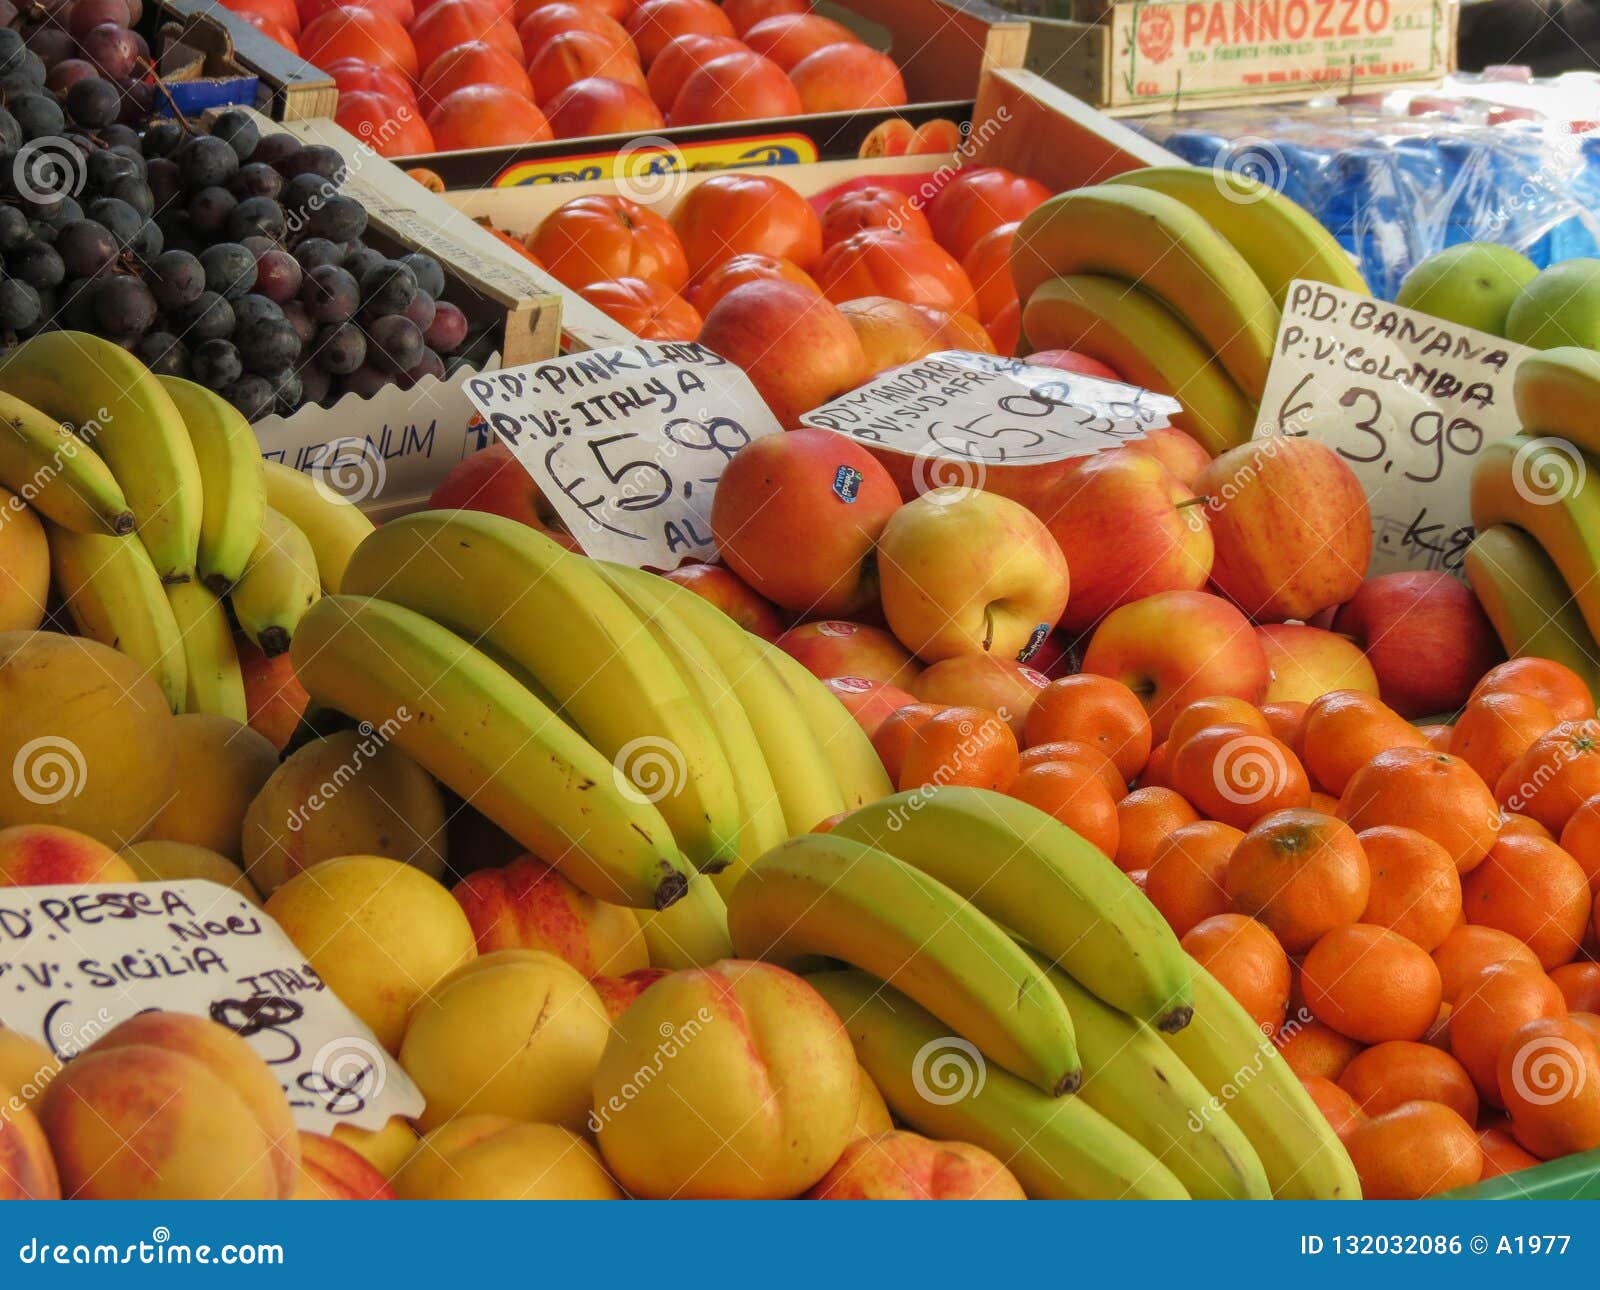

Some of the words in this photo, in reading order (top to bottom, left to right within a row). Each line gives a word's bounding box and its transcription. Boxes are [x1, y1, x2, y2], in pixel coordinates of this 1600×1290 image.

[1183, 0, 1391, 48] PANNOZZO
[1349, 301, 1511, 374] BANANA
[535, 350, 642, 394] PINK
[38, 889, 197, 934] PESCA
